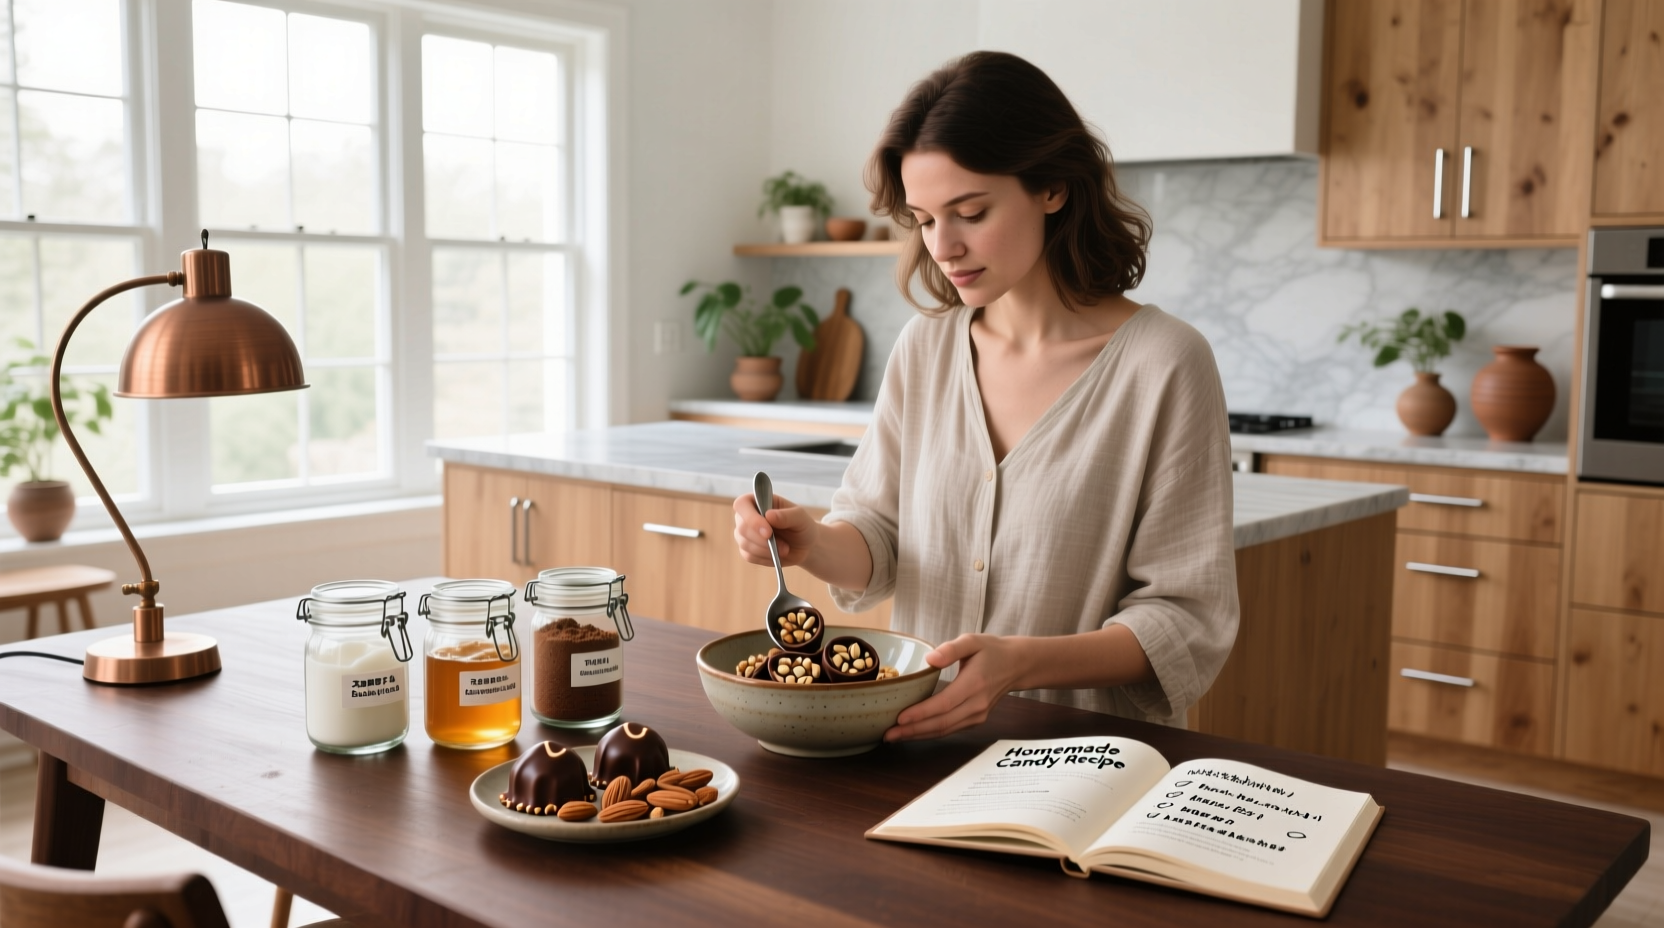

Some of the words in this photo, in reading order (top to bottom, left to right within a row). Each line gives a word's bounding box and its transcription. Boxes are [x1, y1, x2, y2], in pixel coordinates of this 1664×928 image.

[1005, 743, 1121, 757] Homemade
[996, 755, 1060, 769] Candy
[1064, 754, 1126, 770] Recipe
